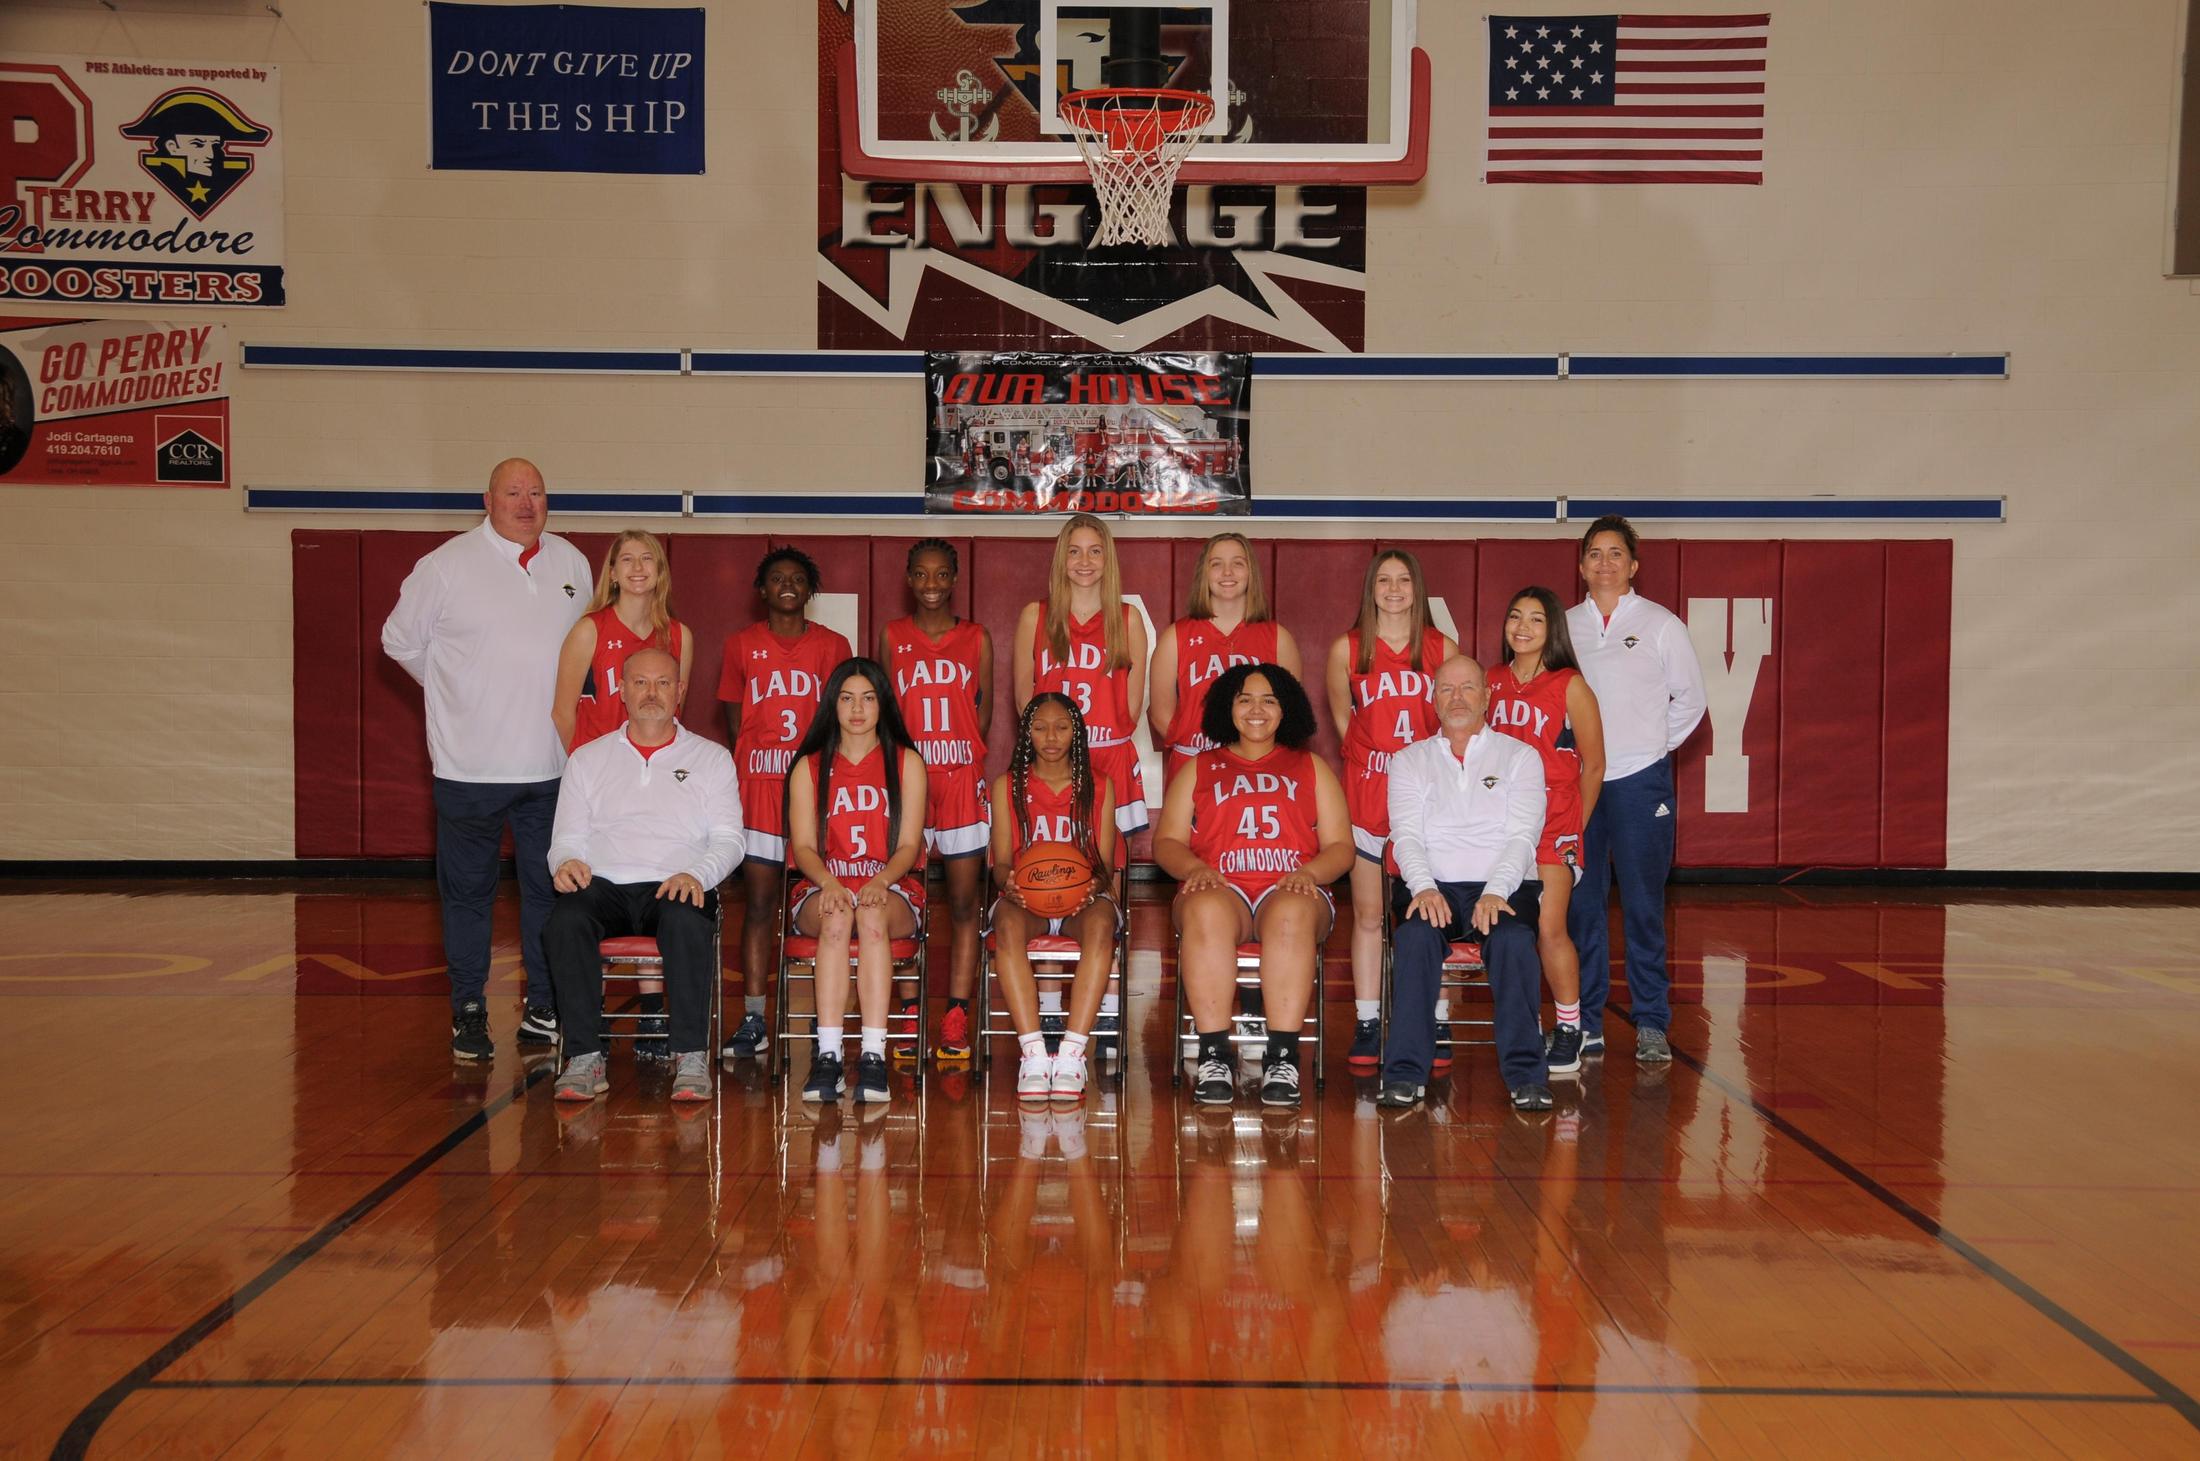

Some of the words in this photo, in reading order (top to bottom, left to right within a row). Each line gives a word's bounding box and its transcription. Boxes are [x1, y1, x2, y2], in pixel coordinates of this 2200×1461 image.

[86, 62, 110, 74] PHS
[112, 63, 164, 77] Athletics
[166, 67, 186, 77] are
[188, 68, 250, 81] supported
[252, 70, 267, 83] by
[448, 50, 546, 77] DONT
[553, 51, 639, 78] GIVE
[649, 52, 692, 80] UP
[472, 102, 561, 131] THE
[575, 100, 686, 134] SHIP
[840, 181, 1342, 249] ENGAGE
[40, 341, 87, 384] GO
[97, 325, 212, 377] PERRY
[40, 362, 223, 415] COMMODORES!
[943, 373, 1045, 404] OUR
[1066, 373, 1232, 405] HOUSE
[46, 431, 72, 442] Jodi
[74, 432, 134, 445] Cartagena
[46, 445, 121, 456] 419.204.7610
[896, 659, 973, 697] LADY
[1041, 643, 1113, 679] LAD
[1359, 670, 1436, 708] LADY
[780, 709, 798, 742] 3
[922, 697, 951, 732] 11
[1393, 709, 1415, 744] 4
[749, 748, 798, 774] COMMO
[826, 785, 890, 819] ADY
[1213, 773, 1298, 807] LADY
[1236, 805, 1281, 840] 45
[850, 825, 867, 859] 5
[1027, 863, 1076, 883] Rawlings
[1219, 847, 1303, 875] COMMODORES
